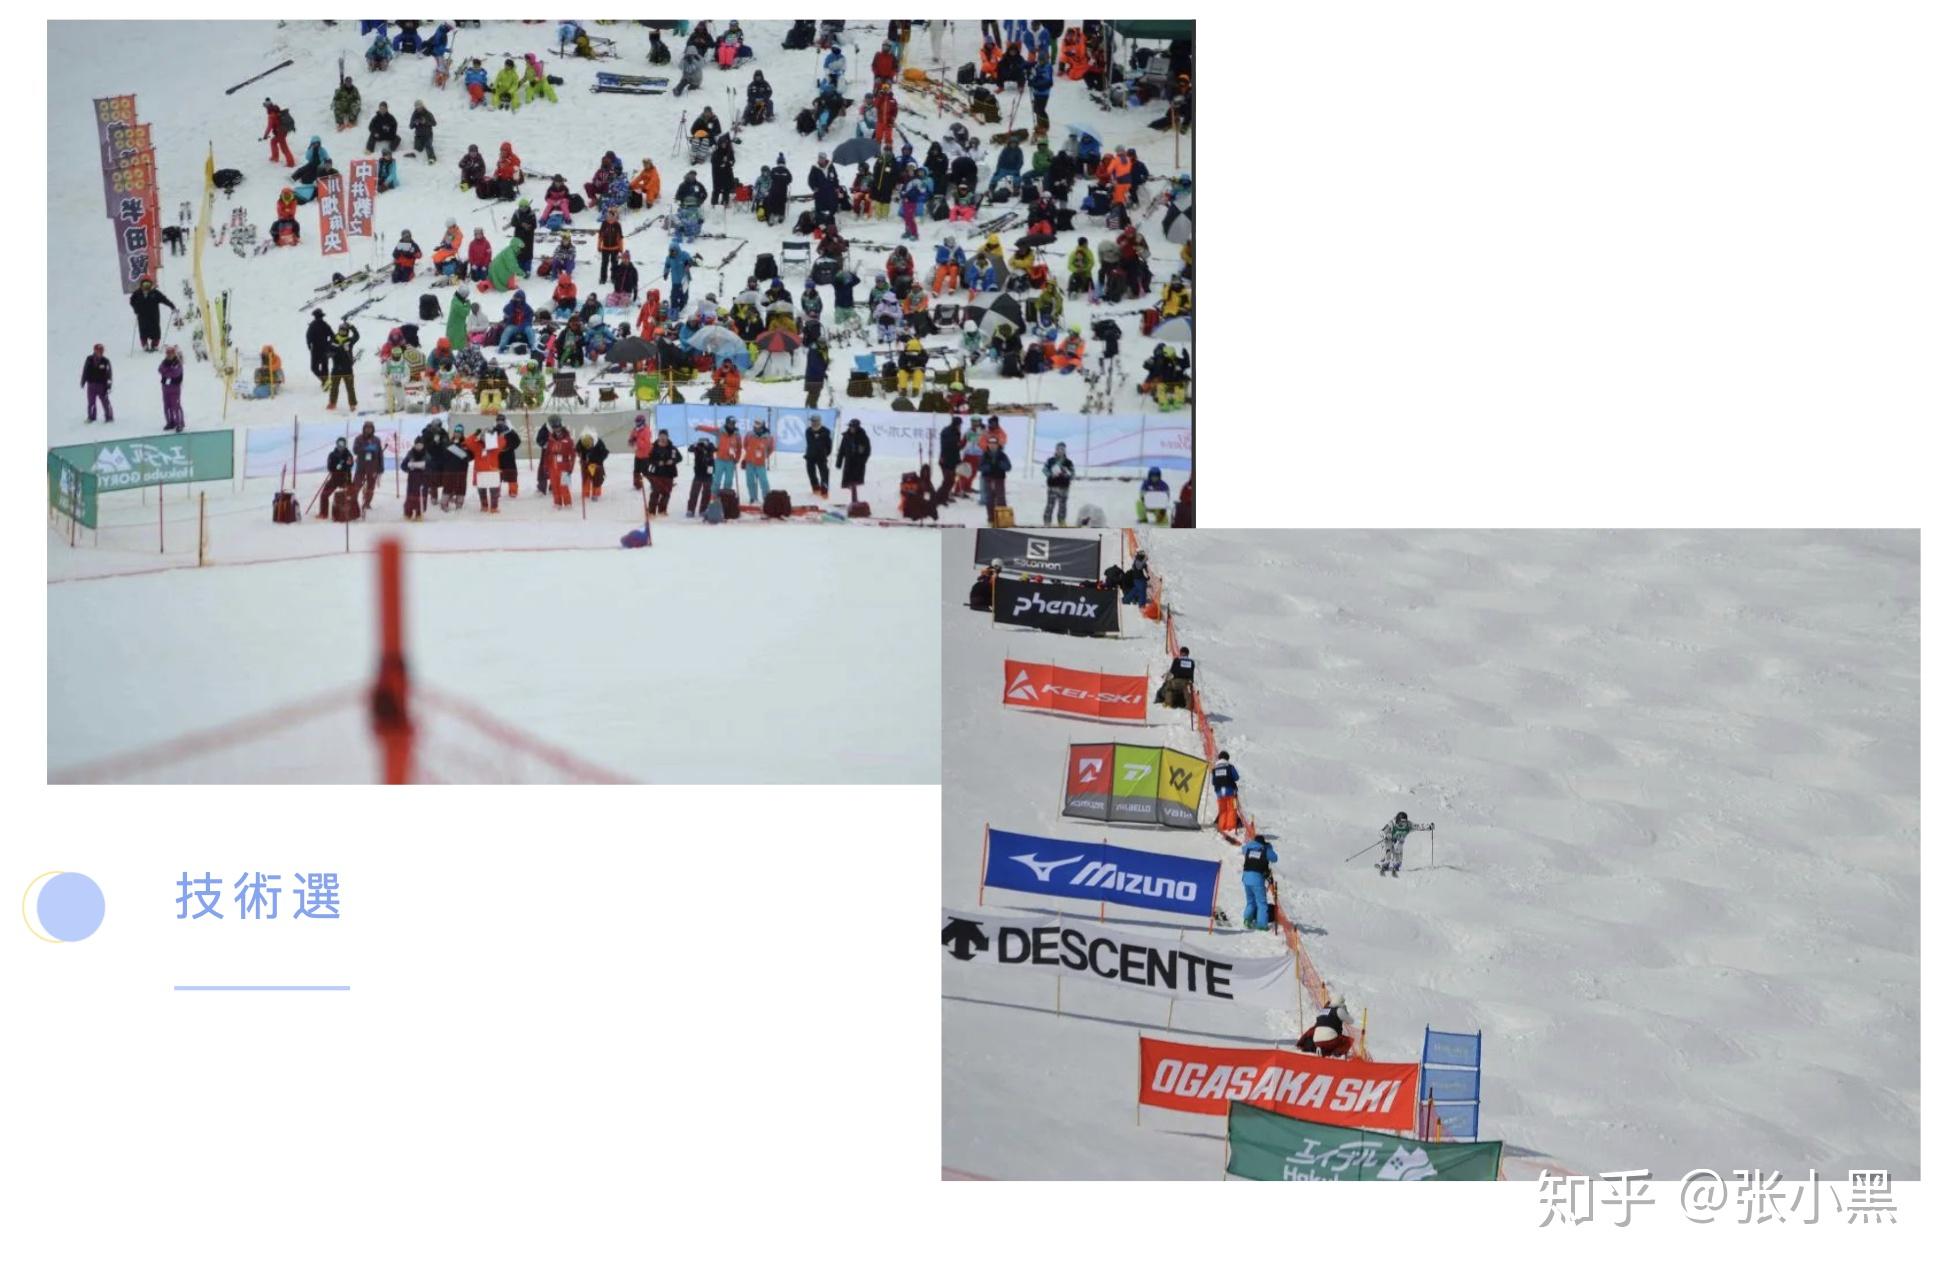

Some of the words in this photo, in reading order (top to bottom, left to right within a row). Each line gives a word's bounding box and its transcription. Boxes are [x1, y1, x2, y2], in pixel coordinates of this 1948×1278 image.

[1013, 592, 1099, 618] phenix
[1041, 683, 1142, 704] KEI-SKI
[998, 926, 1234, 999] DESCENTE
[1151, 1058, 1335, 1109] OGASAKA
[1330, 1078, 1400, 1113] SKI
